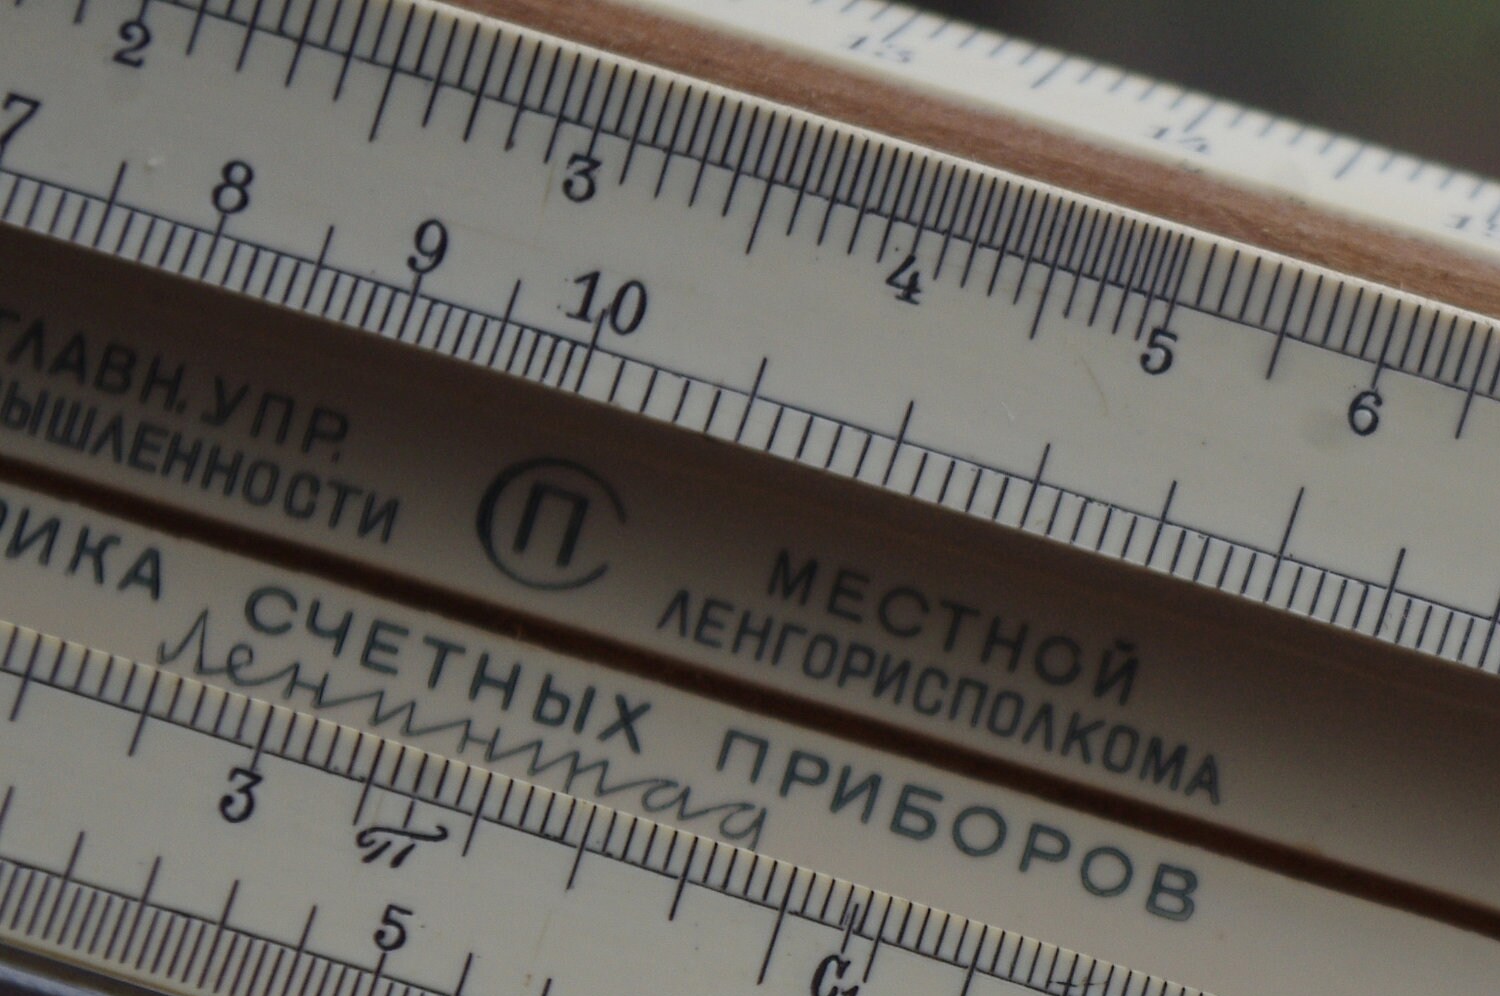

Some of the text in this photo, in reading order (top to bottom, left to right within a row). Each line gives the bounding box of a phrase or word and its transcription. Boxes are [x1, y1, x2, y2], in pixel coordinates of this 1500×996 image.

[0, 92, 41, 148] 7
[211, 160, 254, 214] 8
[406, 219, 449, 275] 9
[565, 270, 648, 336] 10
[113, 20, 152, 69] 2
[560, 154, 603, 202] 3
[886, 254, 921, 305] 4
[1140, 328, 1179, 375] 5
[1347, 390, 1383, 436] 6
[0, 378, 402, 545] ЫШЛЕННОСТИ
[0, 500, 1201, 922] ИКА СЧЕТНЫХ ПРИБОРОВ
[656, 588, 1222, 805] ЛЕНГОРИСПОЛКОМА
[766, 549, 1141, 706] МЕСТНОЙ
[219, 767, 262, 823] 3
[373, 904, 412, 951] 5
